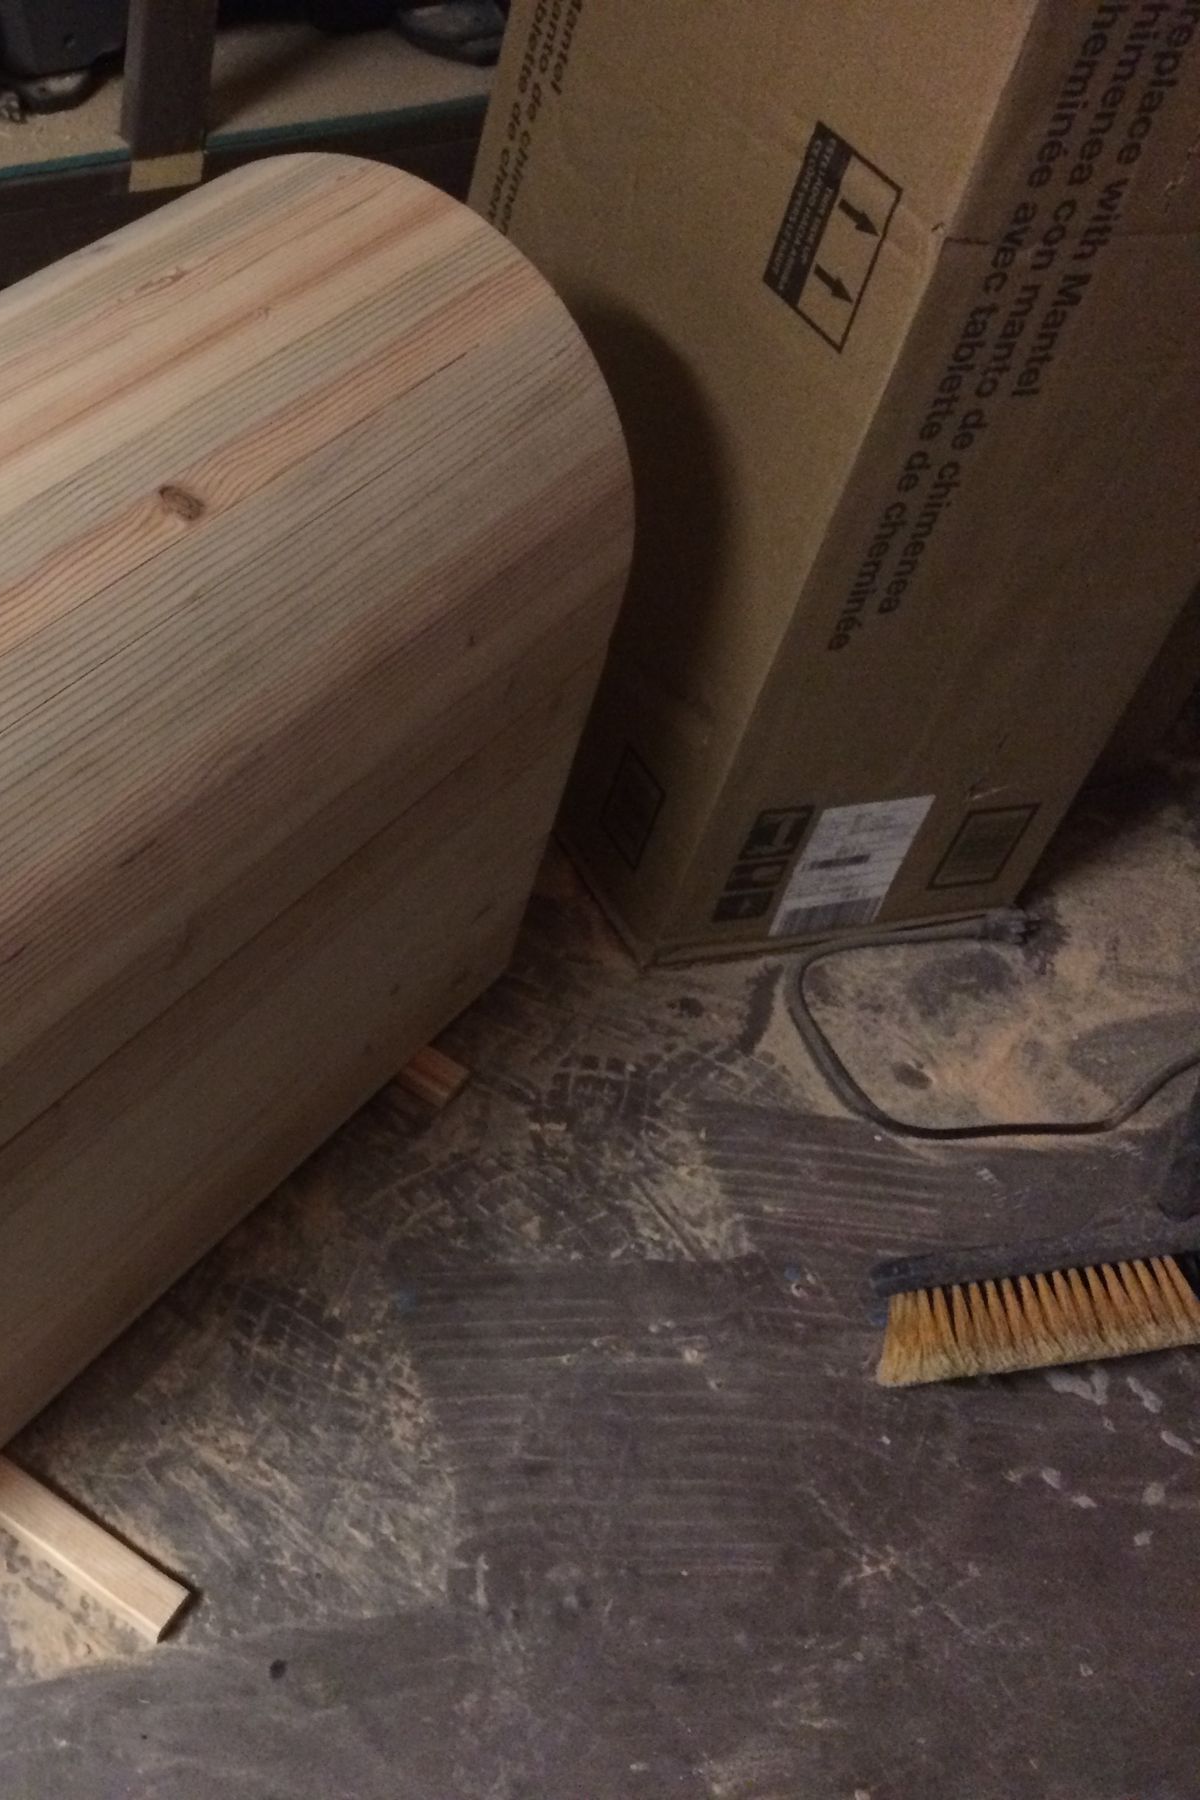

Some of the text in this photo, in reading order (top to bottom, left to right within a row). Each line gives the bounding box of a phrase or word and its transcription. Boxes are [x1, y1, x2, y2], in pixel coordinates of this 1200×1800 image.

[518, 0, 547, 93] blette
[539, 0, 562, 73] anto
[508, 102, 522, 140] de
[527, 83, 541, 121] de
[982, 201, 1038, 294] avec
[1030, 200, 1077, 270] con
[1071, 178, 1130, 260] with
[918, 302, 1000, 441] tablette
[974, 284, 1043, 399] manto
[1010, 273, 1093, 397] Mantel
[897, 450, 932, 492] de
[950, 408, 990, 450] de
[827, 501, 907, 651] cheminée
[877, 461, 961, 614] chimenea
